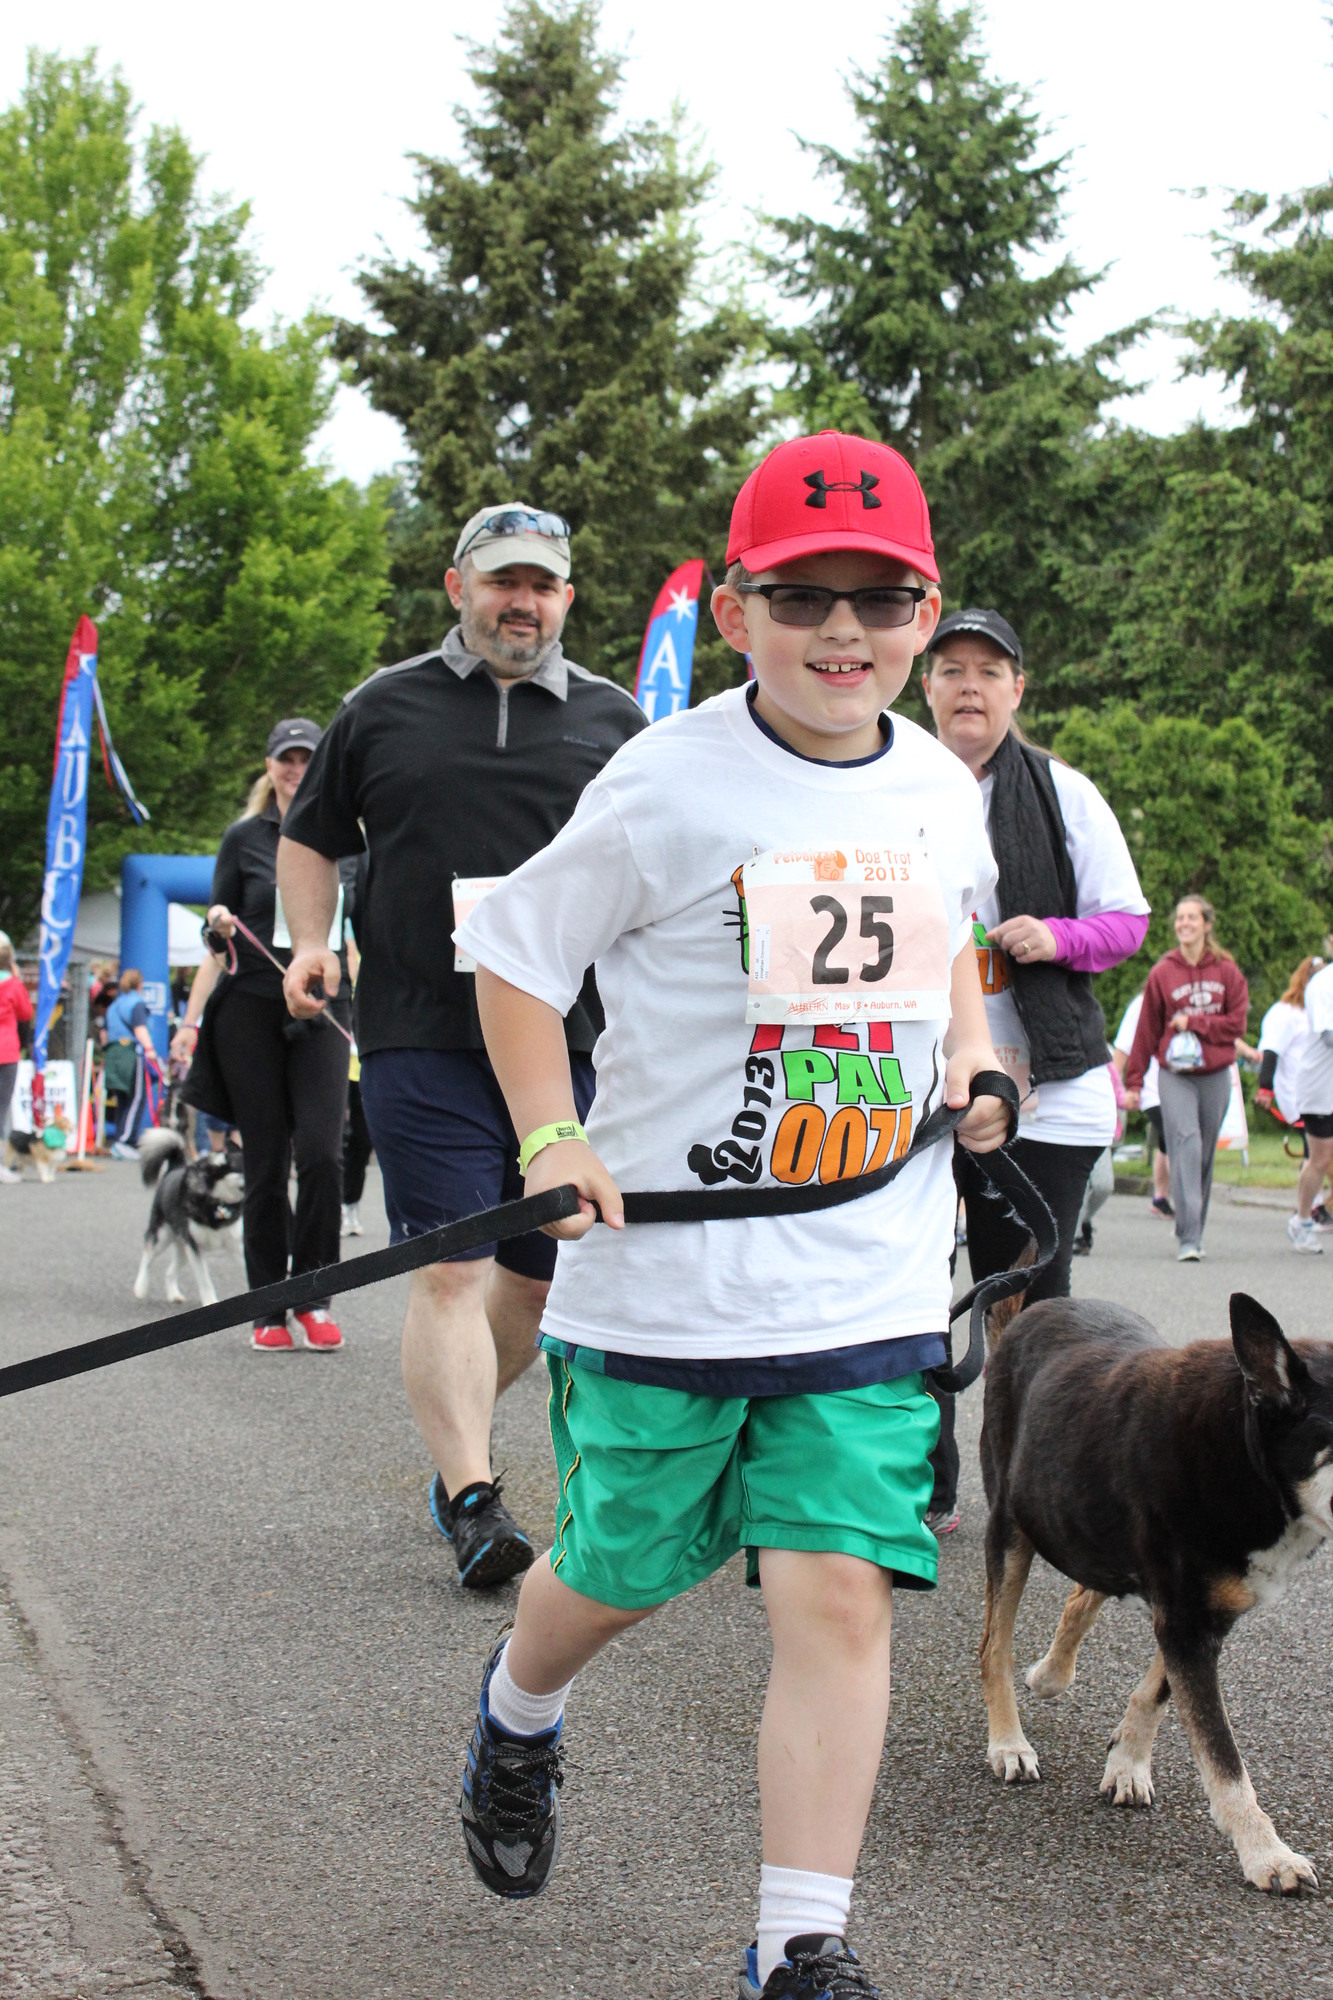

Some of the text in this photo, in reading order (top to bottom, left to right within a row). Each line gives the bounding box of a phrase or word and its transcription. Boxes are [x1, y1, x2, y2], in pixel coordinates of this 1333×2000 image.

[855, 849, 880, 864] Dog
[883, 850, 911, 865] Trot
[863, 866, 910, 882] 2013
[809, 894, 894, 984] 25
[834, 1001, 850, 1011] May
[853, 1001, 862, 1010] 18
[903, 1000, 917, 1009] WA
[780, 1049, 912, 1106] PAL
[713, 1055, 775, 1170] 2013
